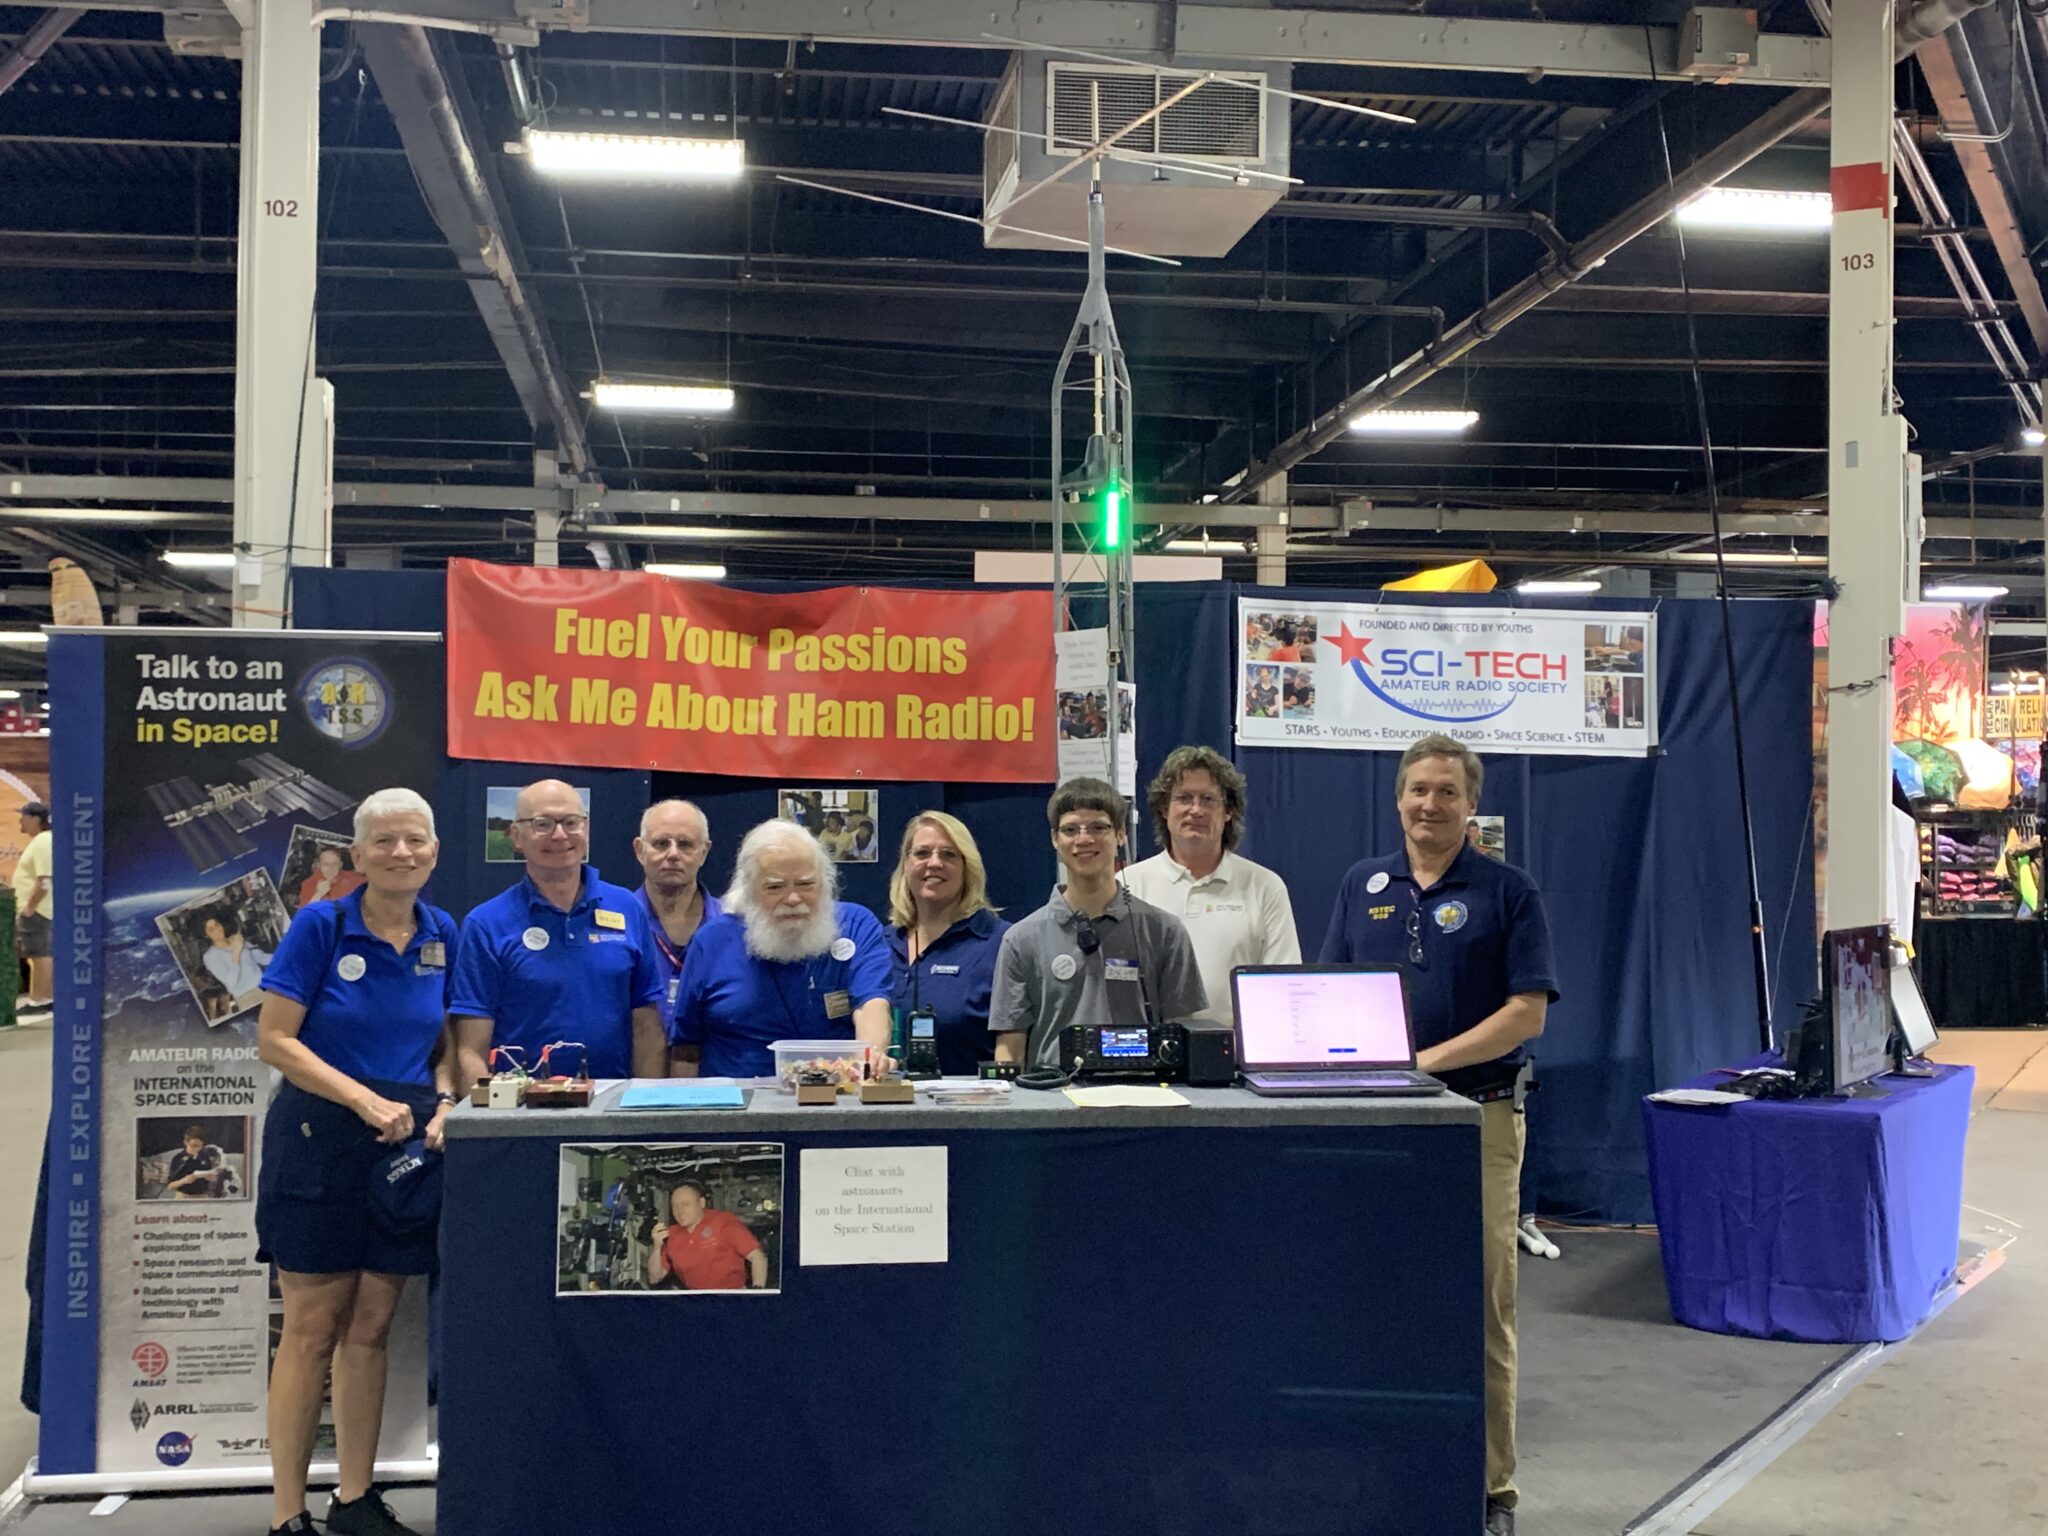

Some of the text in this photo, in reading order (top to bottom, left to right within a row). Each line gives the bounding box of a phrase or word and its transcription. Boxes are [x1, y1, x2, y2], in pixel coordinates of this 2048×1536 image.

[264, 199, 298, 218] 102
[1841, 253, 1874, 271] 103
[1359, 619, 1534, 633] FOUNDED AND DIRECTED BY YOUTHS
[554, 607, 968, 675] Fuel Your Passions
[135, 654, 283, 680] Talk to an
[1380, 648, 1567, 681] SCI-TECH
[1380, 679, 1567, 693] AMATEUR RADIO SOCIETY
[135, 685, 287, 712] Astronaut
[474, 670, 1035, 742] Ask Me About Ham Radio!
[136, 717, 279, 748] in Space!
[1285, 723, 1320, 736] STARS
[1574, 731, 1605, 743] STEM
[67, 791, 94, 1318] INSPIRE EXPLORE EXPERIMENT
[128, 1047, 208, 1063] AMATEUR
[176, 1063, 215, 1074] on the
[133, 1076, 257, 1091] INTERNATIONAL
[135, 1092, 255, 1107] SPACE STATION
[844, 1165, 905, 1177] Chat with
[841, 1186, 904, 1196] astronauts
[815, 1202, 934, 1216] on the International
[134, 1214, 170, 1225] Learn
[143, 1230, 248, 1242] Challenges of space
[833, 1222, 916, 1236] Space Station
[142, 1243, 201, 1253] exploration
[143, 1257, 247, 1269] Space research and
[142, 1269, 263, 1280] space communications
[143, 1285, 239, 1295] Radio science and
[141, 1297, 225, 1308] technology with
[141, 1309, 221, 1319] Amateur Radio
[132, 1379, 167, 1387] AMSAT
[153, 1404, 198, 1416] ARRL
[158, 1444, 191, 1454] NASA
